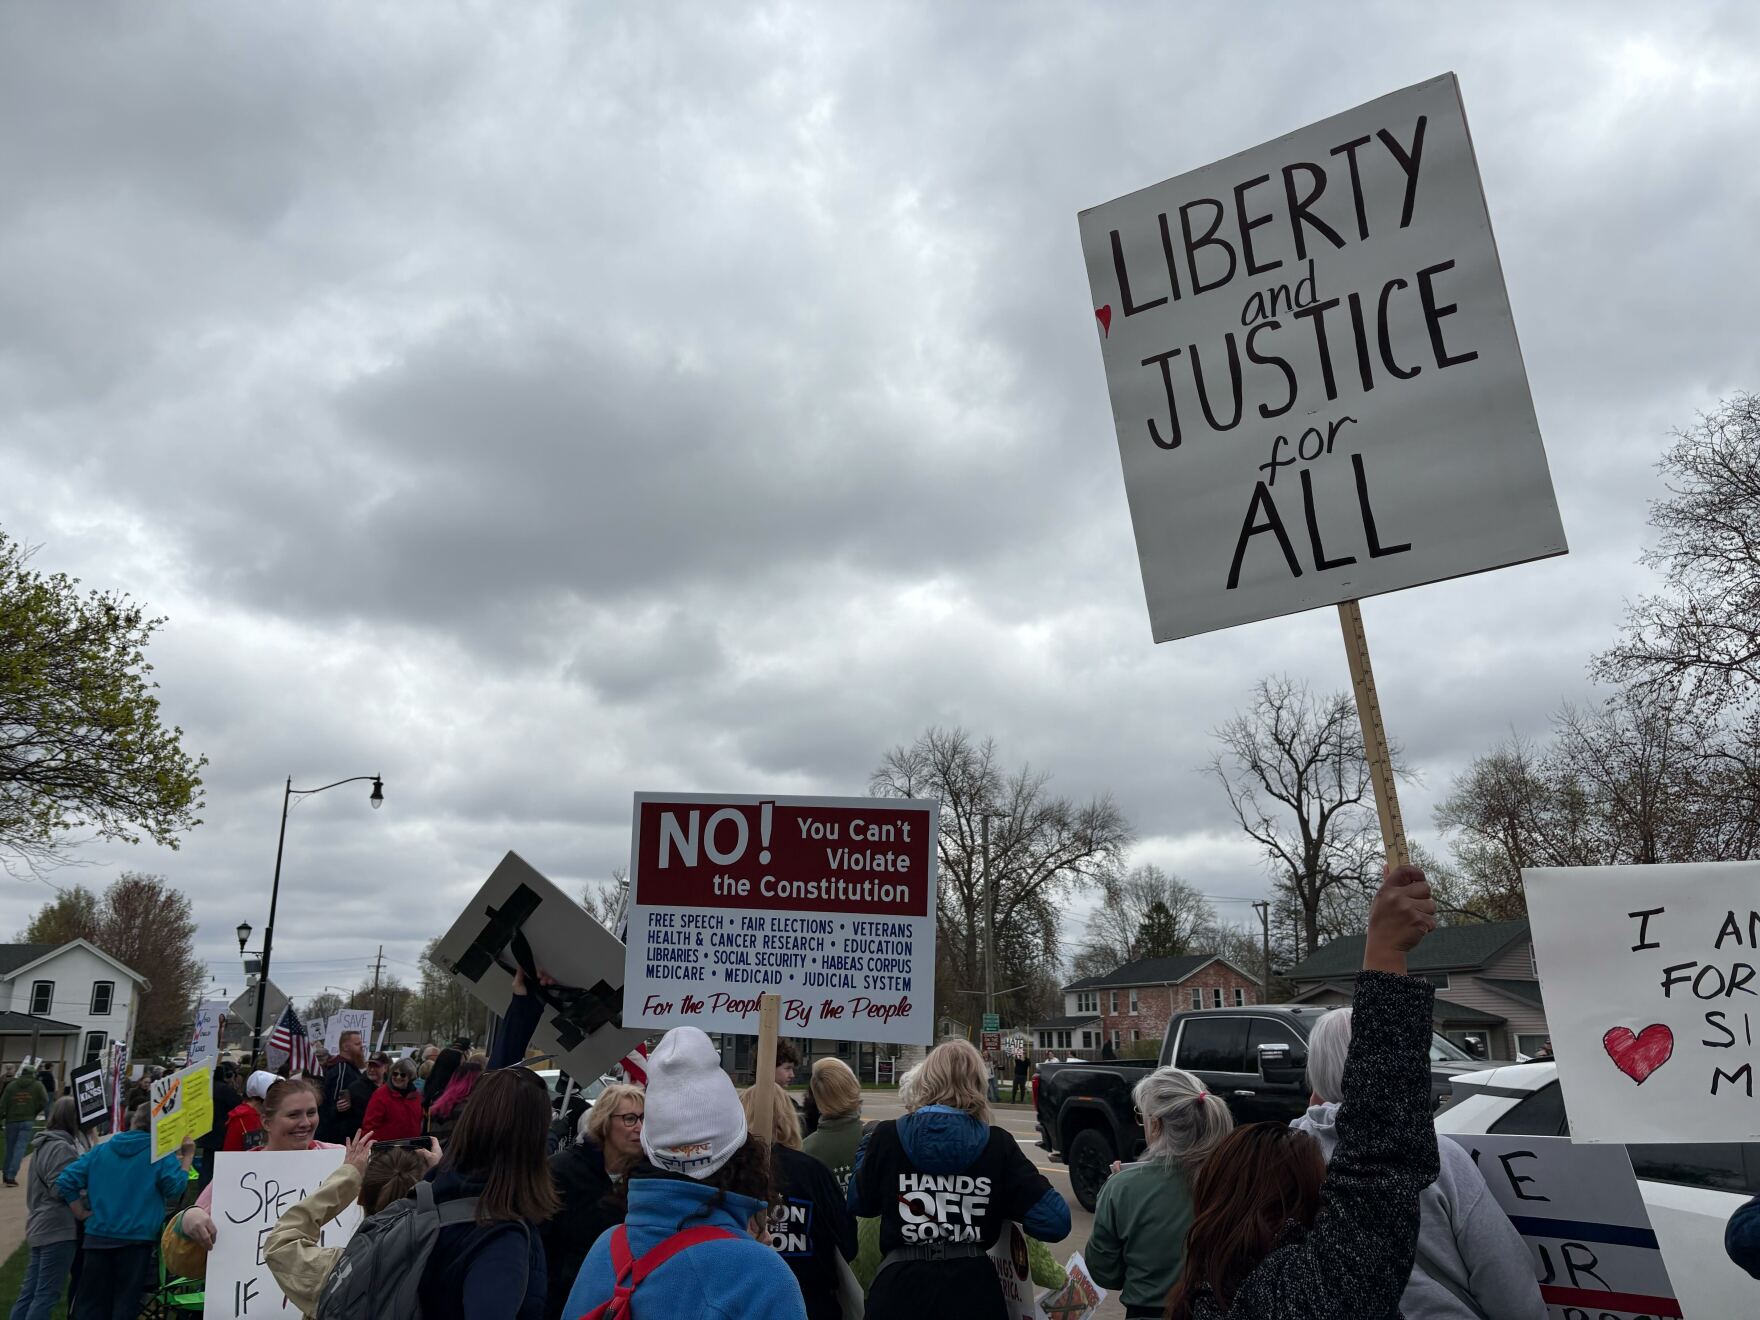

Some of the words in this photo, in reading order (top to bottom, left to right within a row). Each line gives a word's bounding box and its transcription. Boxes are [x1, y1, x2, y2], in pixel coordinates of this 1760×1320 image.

[1110, 116, 1427, 317] LIBERTY
[1241, 259, 1319, 326] and
[1141, 259, 1478, 450] JUSTICE
[1259, 416, 1358, 486] for
[1226, 454, 1412, 589] ALL
[658, 803, 775, 869] NO!
[797, 817, 839, 840] You
[849, 819, 911, 843] Can't
[826, 847, 911, 872] Violate
[712, 874, 750, 896] the
[759, 875, 909, 902] Constitution
[648, 912, 676, 928] FREE
[680, 914, 724, 930] SPEECH
[740, 916, 765, 932] FAIR
[770, 917, 834, 934] ELECTIONS
[852, 921, 912, 939] VETERANS
[1628, 907, 1665, 952] I
[647, 930, 691, 946] HEALTH
[695, 931, 704, 947] &
[710, 932, 757, 948] CANCER
[763, 934, 824, 952] RESEARCH
[844, 938, 912, 957] EDUCATION
[646, 947, 699, 963] LIBRARIES
[713, 950, 751, 966] SOCIAL
[755, 951, 807, 968] SECURITY
[821, 954, 864, 972] HABEAS
[867, 957, 912, 974] CORPUS
[646, 963, 705, 981] MEDICARE
[724, 967, 783, 985] MEDICAID
[802, 971, 857, 989] JUDICIAL
[863, 974, 912, 992] SYSTEM
[1661, 961, 1757, 999] FOR
[642, 994, 673, 1016] For
[681, 994, 705, 1015] the
[708, 991, 766, 1019] Peopl
[784, 998, 812, 1028] By
[819, 998, 845, 1019] the
[848, 995, 913, 1024] People
[343, 1013, 369, 1029] SAVE
[80, 1086, 102, 1102] KINGS
[84, 1081, 95, 1091] NO
[225, 1172, 342, 1227] SPE
[899, 1173, 992, 1196] HANDS
[898, 1191, 990, 1225] OFF
[235, 1277, 260, 1318] IF
